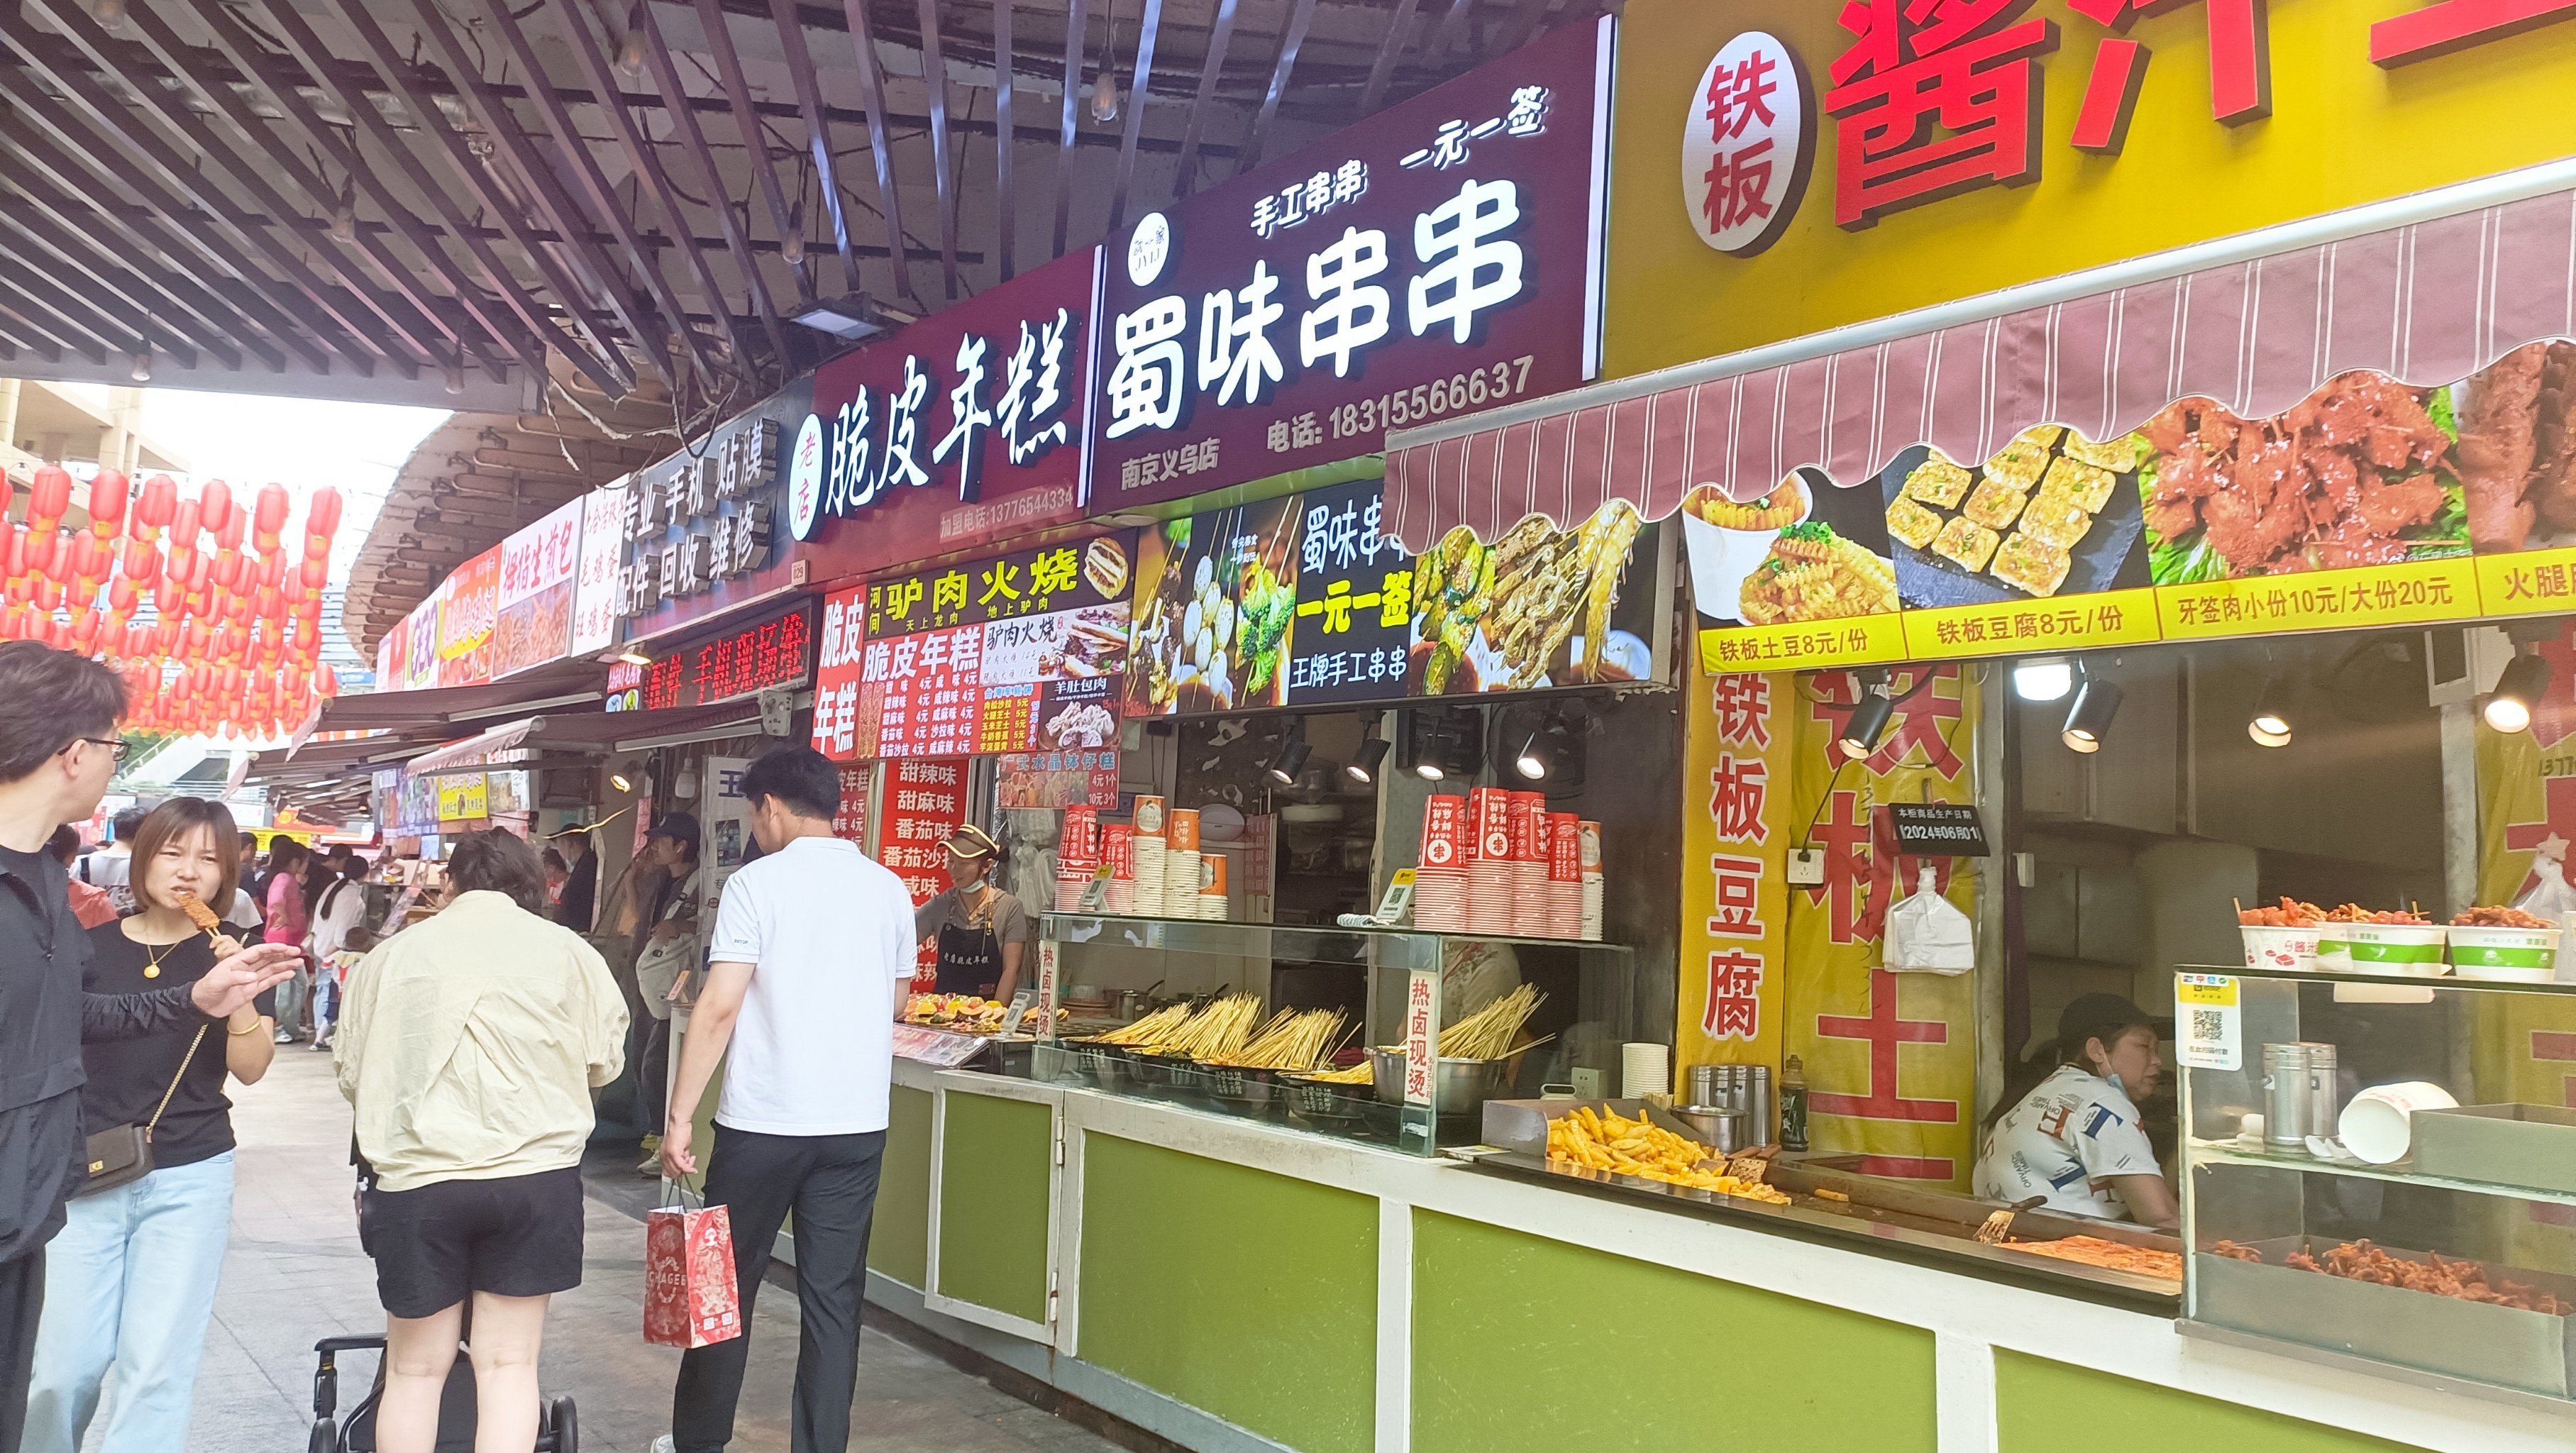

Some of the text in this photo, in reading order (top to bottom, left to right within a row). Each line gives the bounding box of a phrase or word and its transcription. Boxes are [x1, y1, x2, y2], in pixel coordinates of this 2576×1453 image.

[1704, 50, 1777, 236] 铁板
[1251, 86, 1547, 237] 手工串串 一元一签
[1107, 179, 1524, 438] 蜀味串串
[824, 308, 1070, 517] 脆皮年糕
[1120, 355, 1534, 491] 南京义乌店 电话: 18315566637
[624, 417, 763, 542] 专业 手机 贴膜
[794, 431, 815, 524] 老店
[1302, 495, 1404, 574] 蜀味串
[616, 500, 754, 618] 配件 回收 维修
[885, 548, 1078, 621] 驴肉火烧
[2178, 576, 2453, 626] 牙签肉小份10元/大份20元
[2504, 565, 2576, 601] 火腿
[869, 587, 881, 635] 河间
[988, 596, 1049, 617] 地上驴肉
[1296, 570, 1414, 634] 一元一签
[820, 594, 864, 668] 脆皮
[906, 613, 958, 631] 天上龙肉
[987, 616, 1057, 651] 驴肉火烧
[1937, 604, 2123, 644] 铁板豆腐8元/份
[862, 628, 982, 682] 脆皮年糕
[1720, 628, 1868, 662] 铁板土豆8元/份
[919, 676, 932, 690] 4元
[963, 671, 977, 685] 4元
[1290, 645, 1407, 689] 王牌手工串串
[917, 693, 930, 707] 4元
[962, 689, 975, 702] 4元
[984, 684, 1034, 700] 台湾车轮饼
[1017, 698, 1028, 707] 5元
[1054, 678, 1107, 694] 羊肚包肉
[813, 681, 857, 754] 年糕
[914, 726, 927, 739] 4元
[958, 723, 972, 736] 4元
[916, 709, 928, 723] 4元
[961, 706, 973, 719] 4元
[1015, 719, 1026, 729] 5元
[1016, 709, 1027, 718] 5元
[912, 743, 925, 756] 4元
[957, 740, 970, 753] 4元
[1012, 741, 1024, 750] 5元
[1014, 730, 1025, 739] 5元
[899, 761, 956, 785] 甜辣味
[1002, 752, 1115, 772] 广式水晶钵仔糕
[851, 799, 865, 813] 4元
[897, 790, 955, 814] 甜麻味
[851, 817, 863, 832] 4元
[895, 818, 953, 840] 番茄味
[1704, 673, 1769, 1036] 铁板豆腐
[1809, 665, 1965, 1179] 铁板土
[1039, 946, 1053, 1036] 热卤现烫
[1408, 979, 1430, 1098] 热卤现烫
